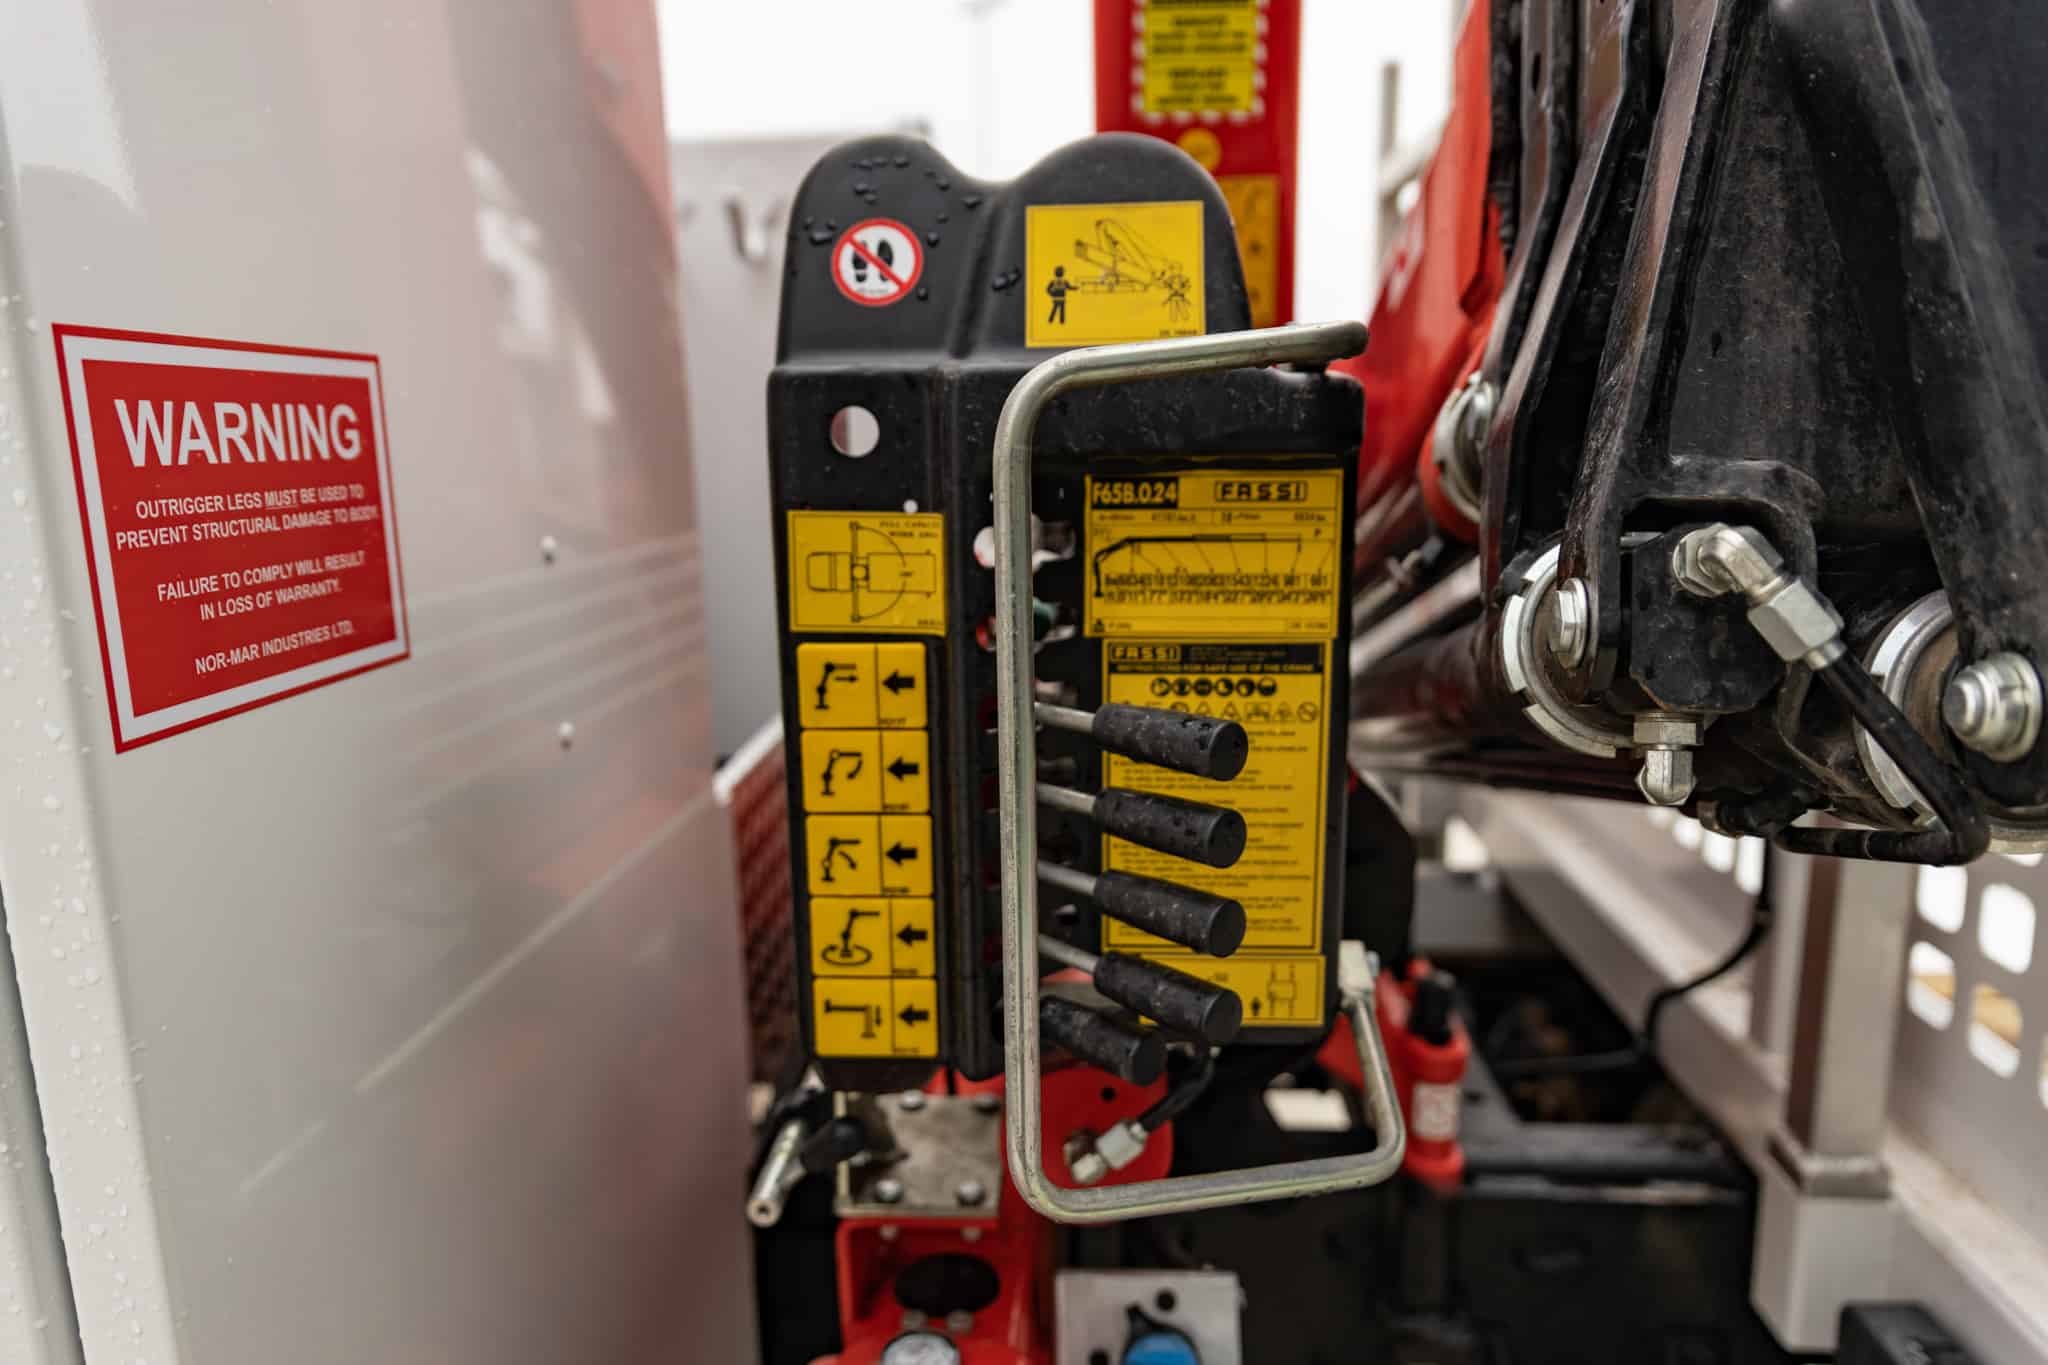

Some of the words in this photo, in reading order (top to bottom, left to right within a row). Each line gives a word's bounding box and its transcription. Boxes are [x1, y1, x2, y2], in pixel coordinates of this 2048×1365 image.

[114, 399, 362, 467] WARNING
[136, 496, 224, 519] OUTRIGGER
[227, 492, 262, 510] LEGS
[264, 489, 298, 508] MUST
[300, 488, 316, 503] BE
[319, 485, 347, 501] USED
[349, 484, 364, 499] TO
[1220, 483, 1304, 500] FASSI
[116, 526, 194, 550] PREVENT
[192, 516, 281, 541] STRUCTURAL
[282, 510, 332, 529] DAMAGE
[333, 508, 349, 522] TO
[157, 575, 219, 602] FAILURE
[221, 572, 241, 589] TO
[243, 562, 294, 585] COMPLY
[295, 558, 323, 576] WILL
[324, 550, 365, 570] RESULT
[200, 603, 215, 620] IN
[218, 597, 254, 617] LOSS
[255, 592, 274, 609] OF
[275, 579, 341, 604] WARRANTY.
[195, 644, 260, 675] NOR-MAR
[262, 627, 331, 656] INDUSTRIES
